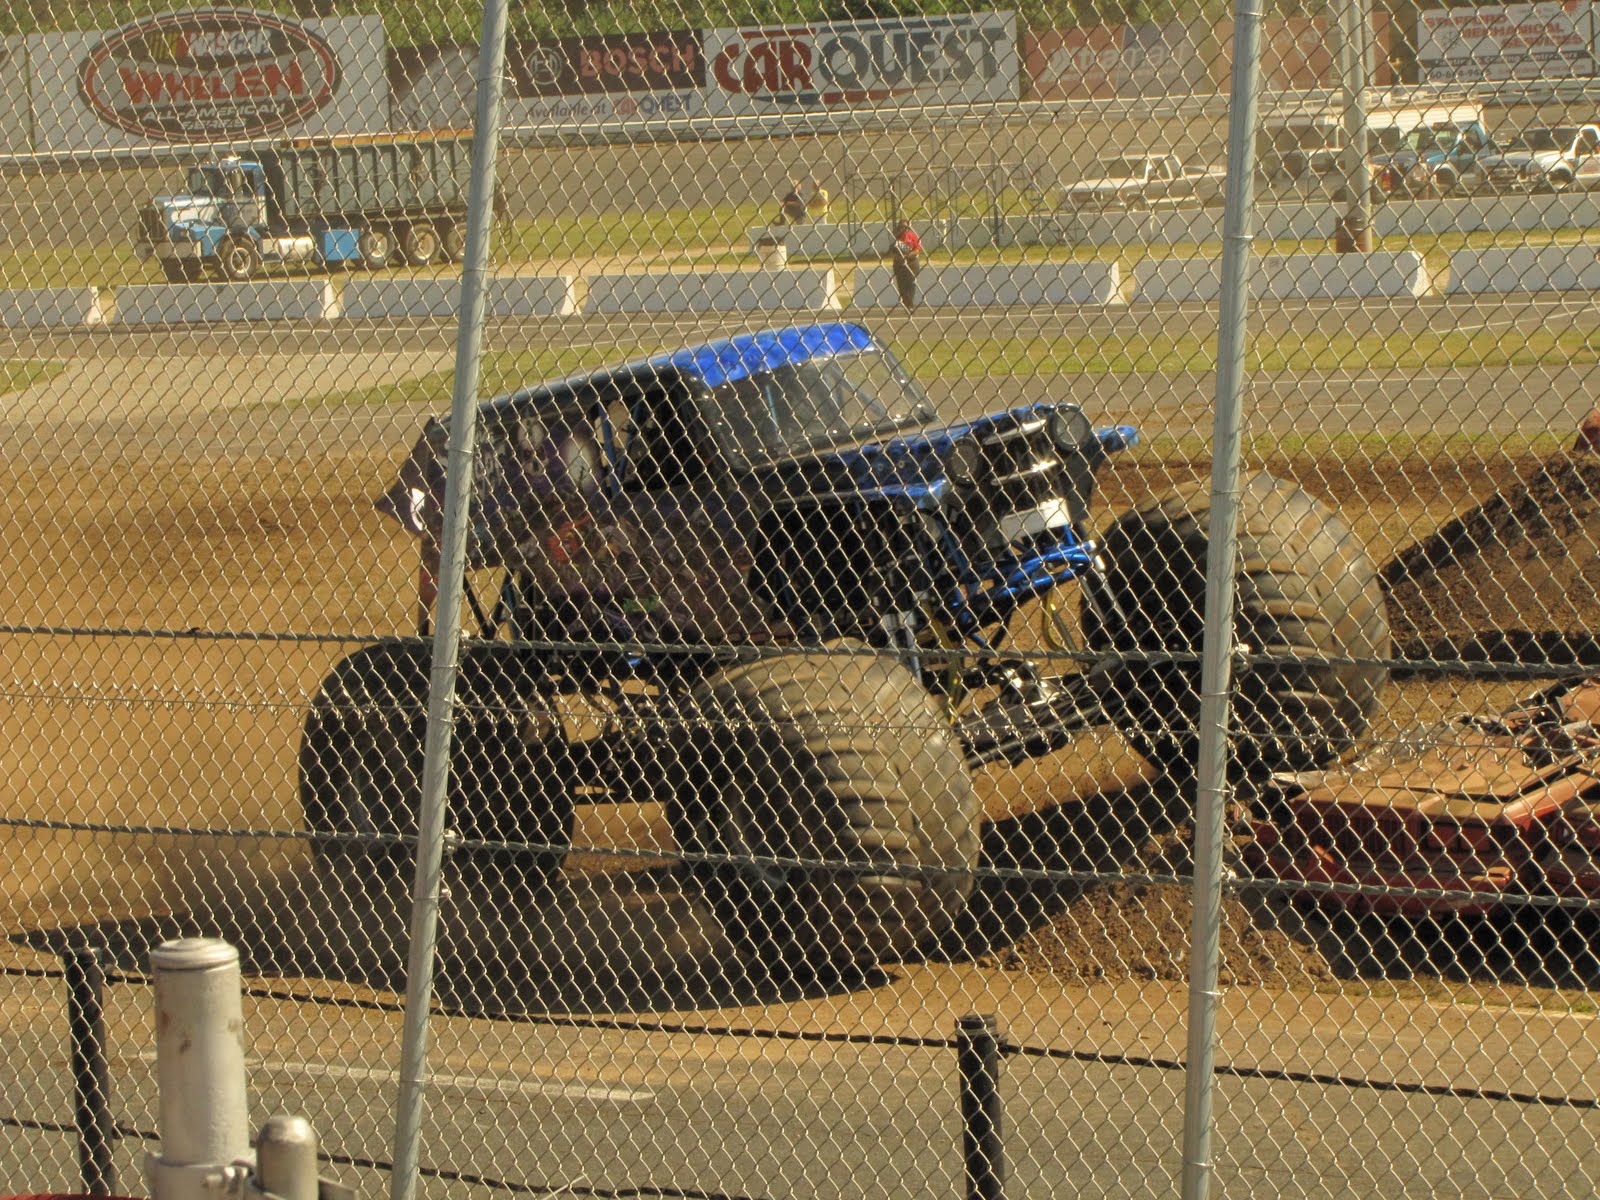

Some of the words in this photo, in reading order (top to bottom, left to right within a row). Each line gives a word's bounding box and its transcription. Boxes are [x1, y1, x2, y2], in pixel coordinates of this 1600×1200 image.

[579, 44, 696, 78] BOSCH
[118, 60, 304, 104] WHELEN
[142, 103, 286, 121] ALL-AMERICAN
[525, 102, 588, 119] Available
